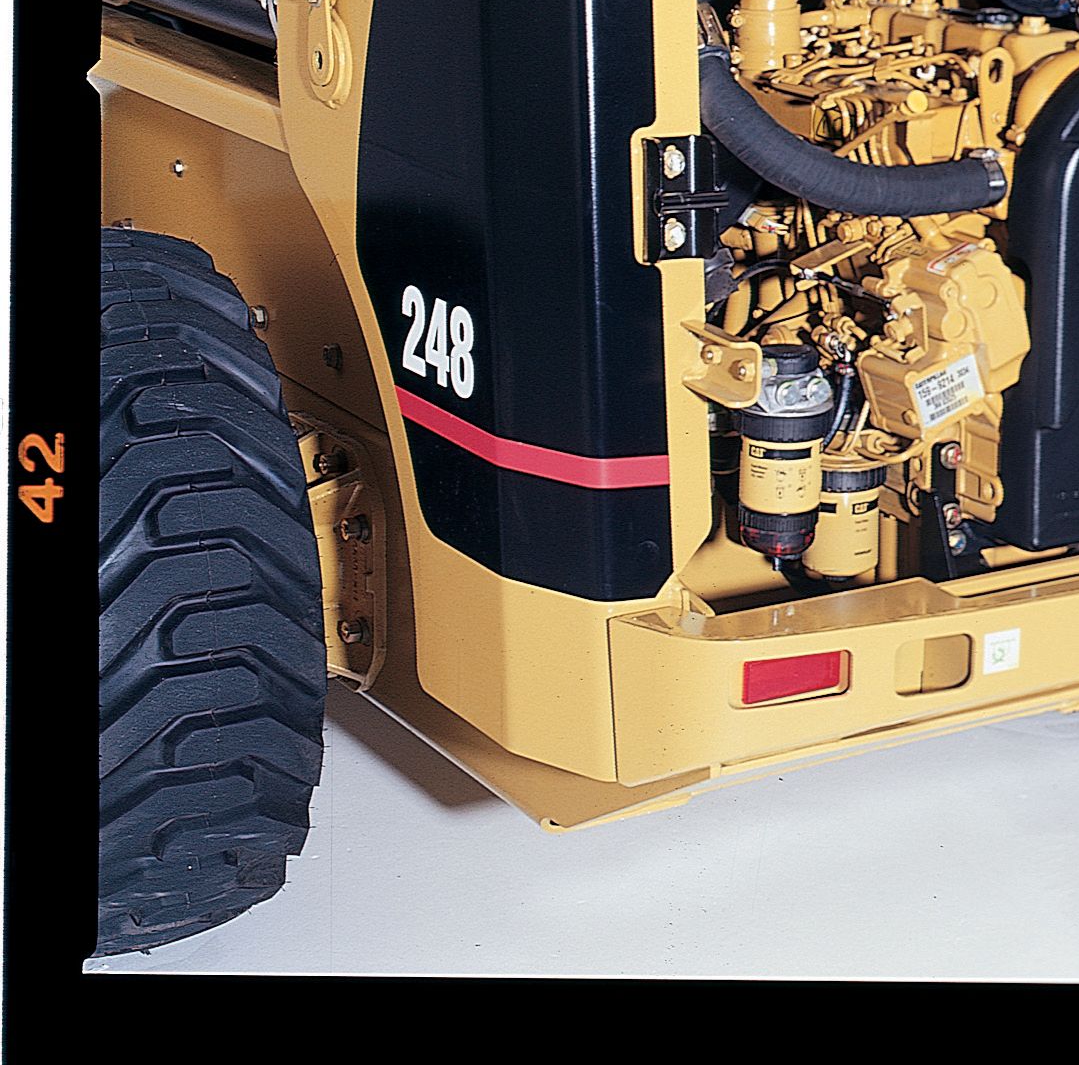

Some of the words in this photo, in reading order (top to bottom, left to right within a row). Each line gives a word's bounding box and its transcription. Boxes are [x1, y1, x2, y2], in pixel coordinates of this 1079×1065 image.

[401, 285, 475, 399] 248
[18, 432, 65, 523] 42
[750, 445, 767, 458] CAT
